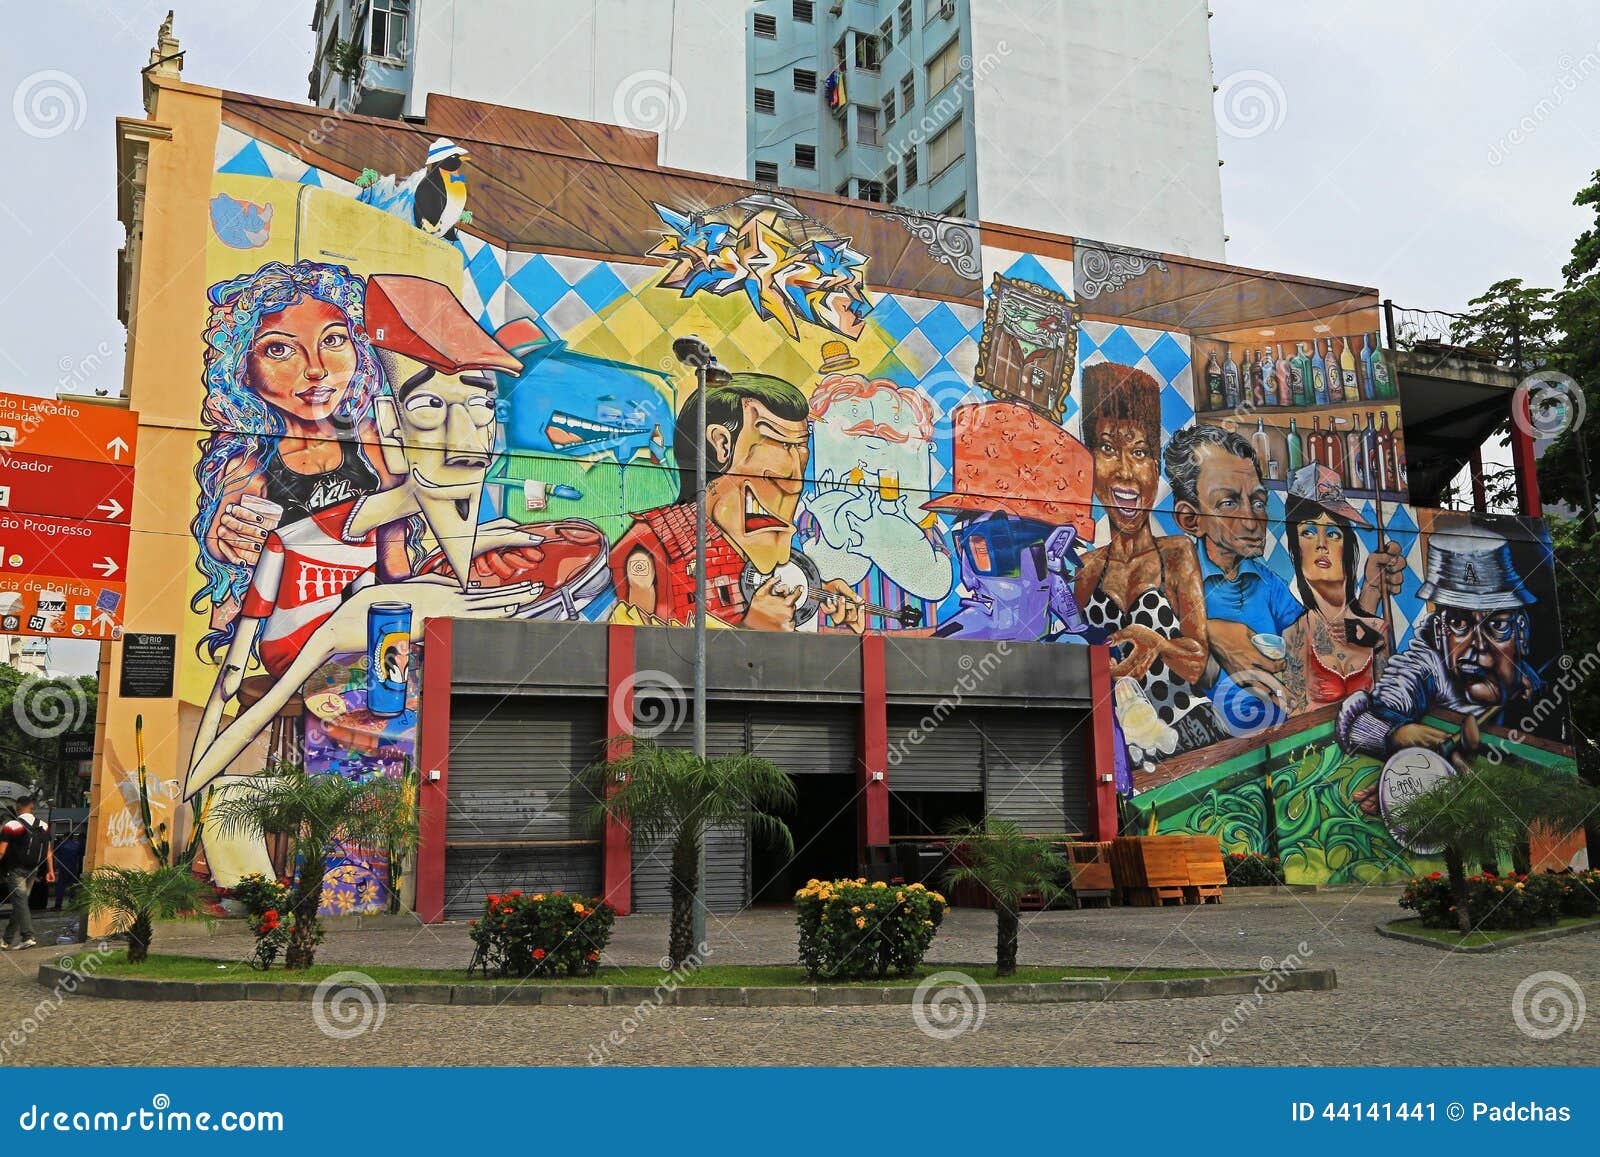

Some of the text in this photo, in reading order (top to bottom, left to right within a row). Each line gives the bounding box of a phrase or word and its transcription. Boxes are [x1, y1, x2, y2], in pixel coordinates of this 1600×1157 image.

[22, 400, 80, 418] Lavradio
[1, 456, 53, 473] Voador
[23, 519, 92, 537] Progresso
[23, 580, 42, 593] de
